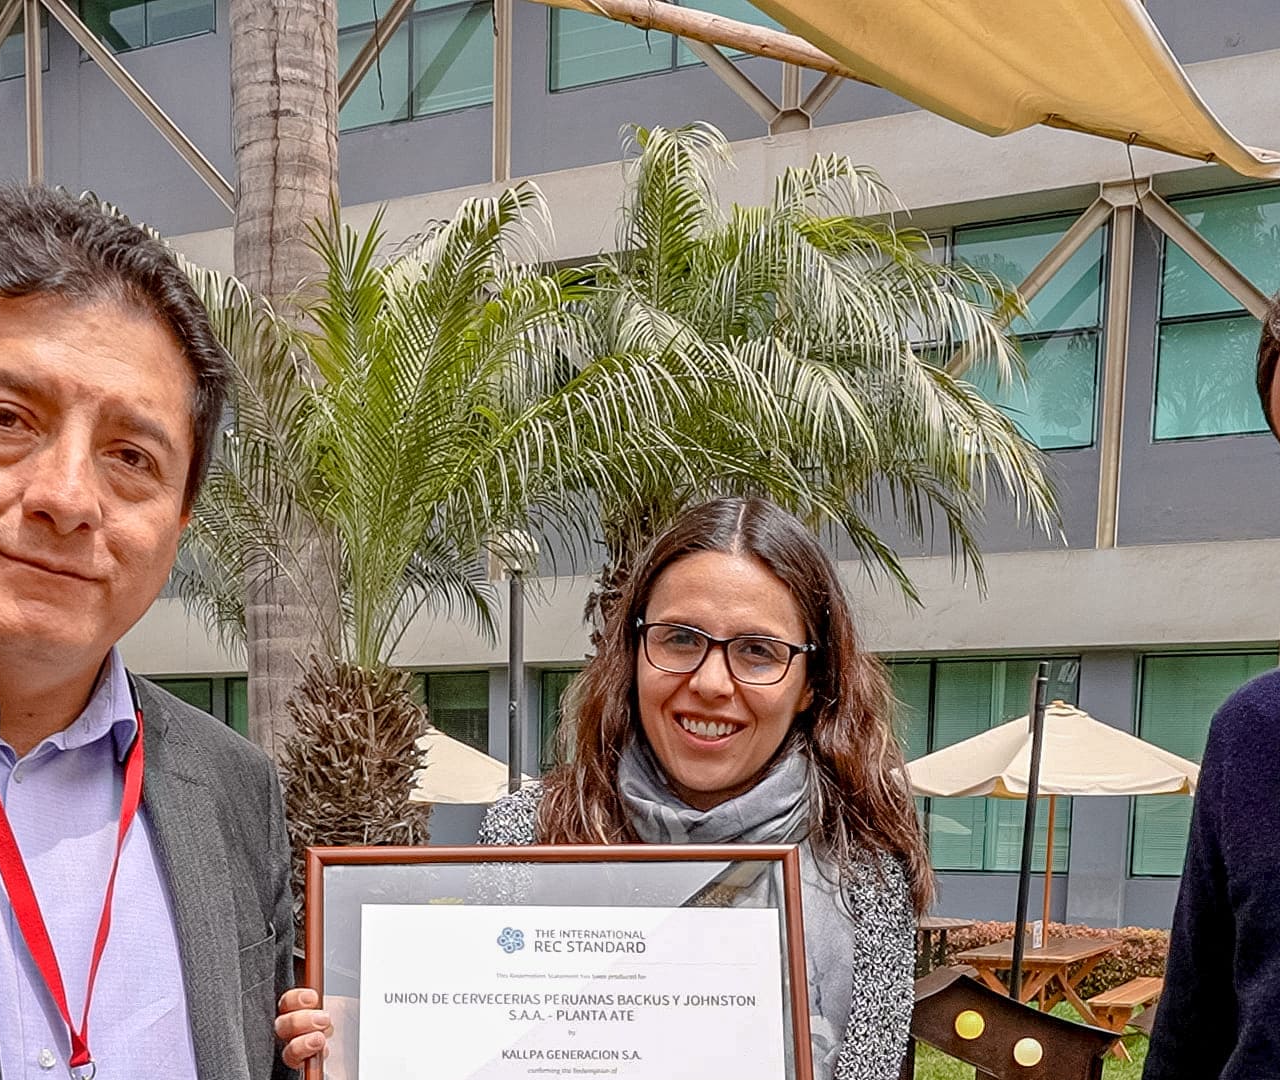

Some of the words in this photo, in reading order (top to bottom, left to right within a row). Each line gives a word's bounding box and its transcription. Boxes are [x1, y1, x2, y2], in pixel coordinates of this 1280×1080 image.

[535, 929, 556, 939] THE
[559, 929, 646, 940] INTERNATIONAL
[534, 940, 562, 953] REC
[566, 941, 646, 954] STANDARD
[384, 993, 428, 1004] UNION
[432, 993, 449, 1005] DE
[452, 993, 541, 1005] CERVECERIAS
[544, 994, 614, 1006] PERUANAS
[617, 994, 670, 1006] BACKUS
[672, 995, 680, 1006] Y
[683, 995, 756, 1007] JOHNSTON
[508, 1009, 545, 1021] S.A.A.
[556, 1010, 607, 1021] PLANTA
[609, 1010, 635, 1022] ATE
[502, 1050, 544, 1060] KALLPA
[546, 1050, 619, 1060] GENERACION
[622, 1050, 642, 1060] S.A.
